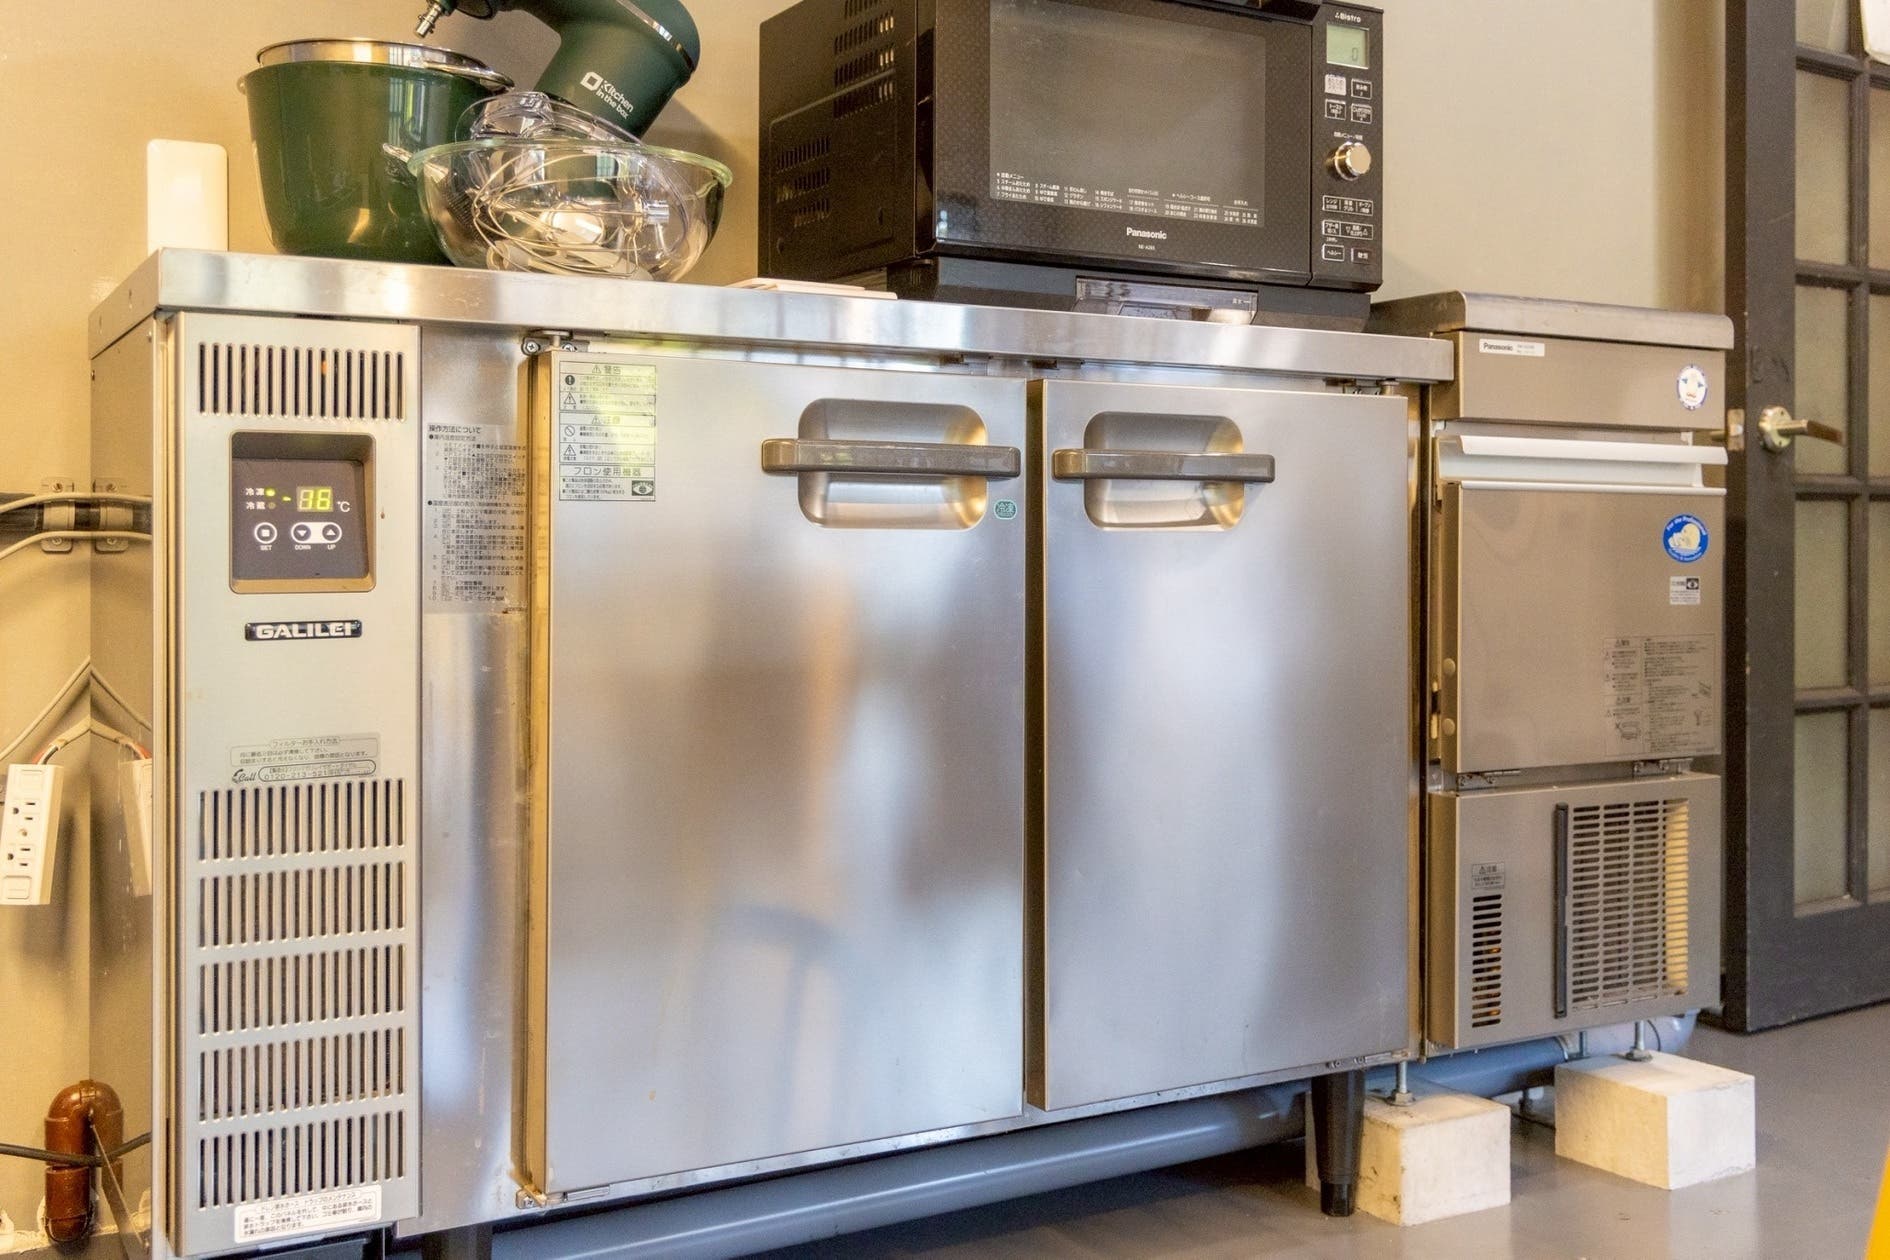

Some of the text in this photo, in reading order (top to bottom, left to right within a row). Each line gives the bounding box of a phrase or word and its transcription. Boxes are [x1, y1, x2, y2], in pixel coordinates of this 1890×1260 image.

[1351, 47, 1358, 61] 0
[603, 80, 634, 112] Kitchen
[604, 95, 617, 108] the
[616, 104, 629, 120] box
[1126, 226, 1167, 240] Panasonic
[1483, 342, 1513, 351] Panasonic
[429, 425, 481, 434] 操作方法について
[574, 466, 641, 477] フロン使用機器
[255, 622, 353, 640] GALILEI
